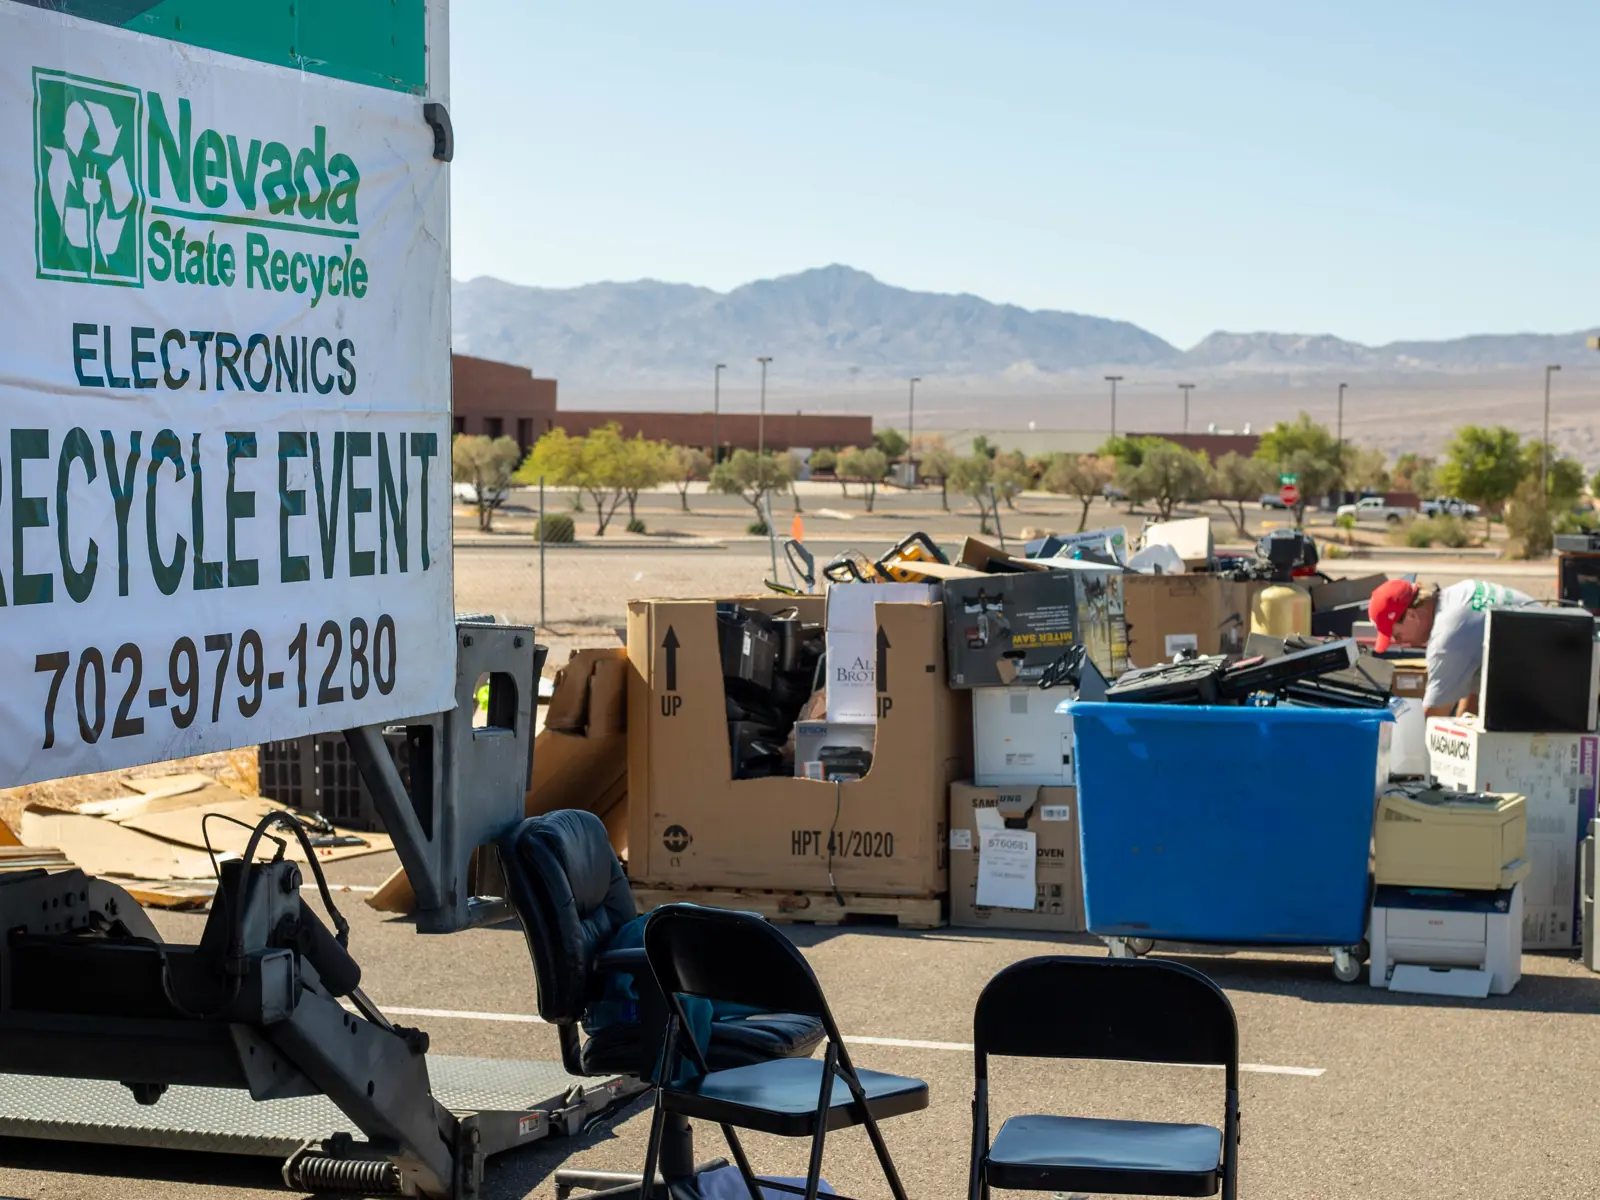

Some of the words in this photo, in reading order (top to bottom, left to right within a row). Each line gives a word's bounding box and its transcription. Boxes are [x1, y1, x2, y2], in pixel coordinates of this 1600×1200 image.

[148, 91, 361, 226] Nevada
[147, 219, 236, 288] State
[246, 232, 369, 308] Recycle
[72, 322, 357, 396] ELECTRONICS
[0, 426, 260, 607] ECYCLE
[277, 431, 439, 583] EVENT
[1012, 633, 1036, 645] SAW
[1039, 631, 1073, 642] MITER
[852, 656, 876, 671] AL
[34, 613, 397, 750] 702-979-1280
[661, 695, 682, 717] UP
[1430, 733, 1471, 760] MAGNAVOX
[791, 830, 821, 856] HPT
[827, 831, 894, 858] 41/2020
[1037, 848, 1065, 858] OVEN
